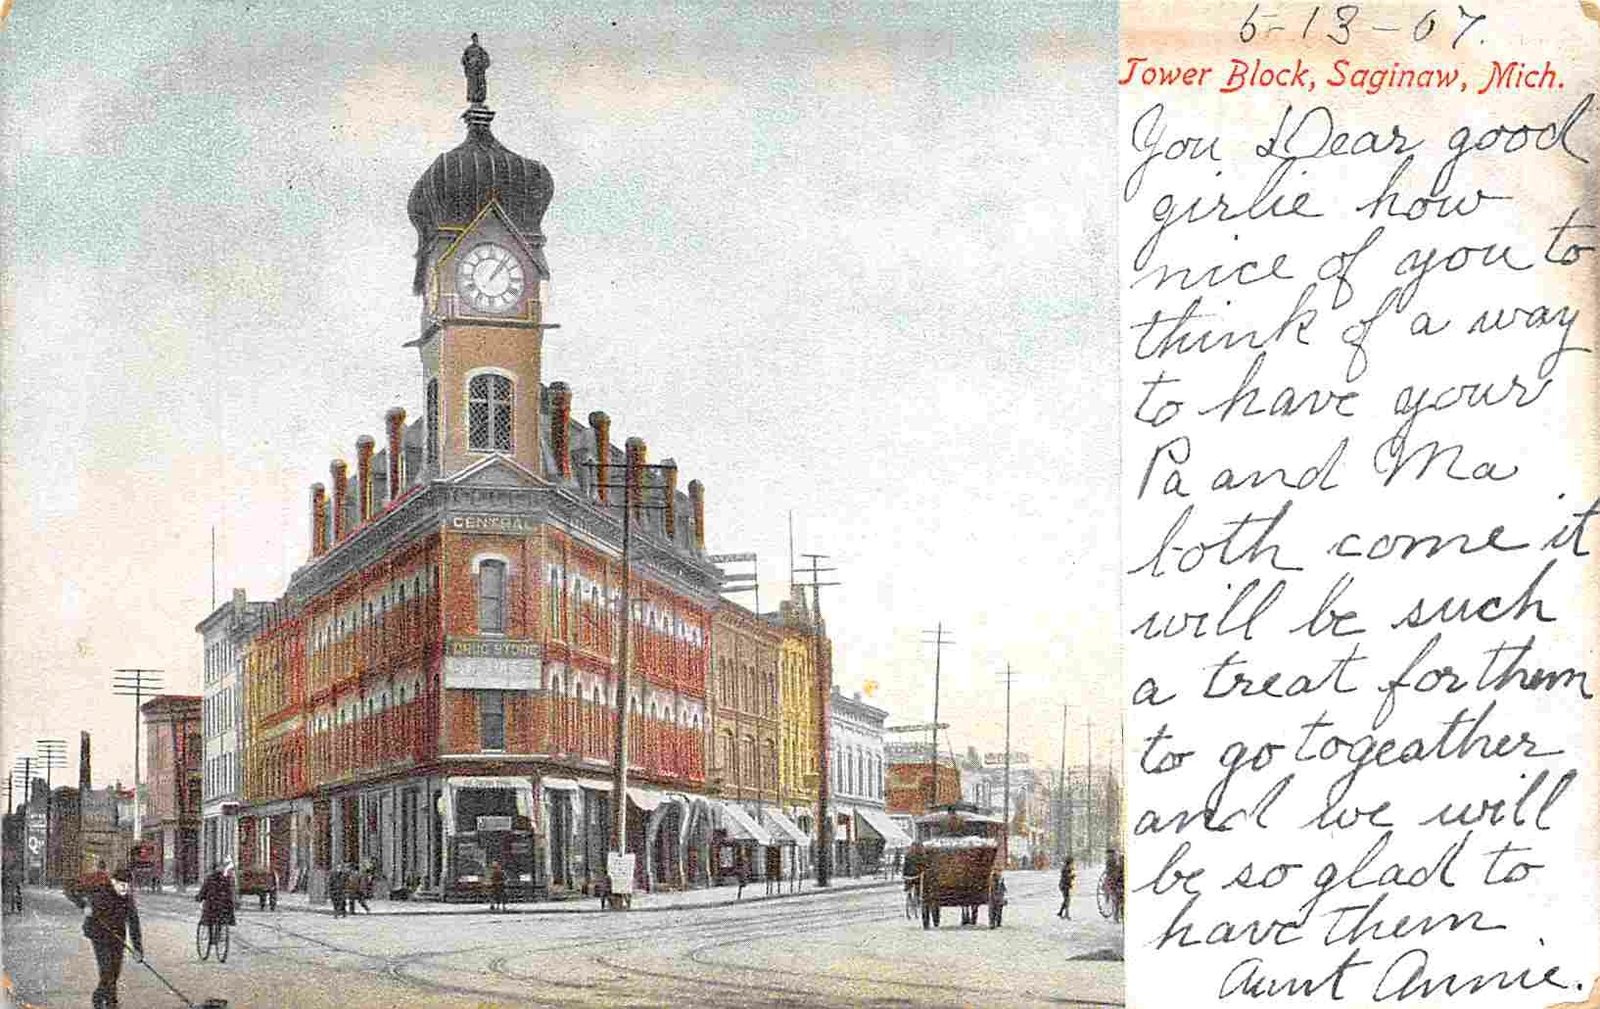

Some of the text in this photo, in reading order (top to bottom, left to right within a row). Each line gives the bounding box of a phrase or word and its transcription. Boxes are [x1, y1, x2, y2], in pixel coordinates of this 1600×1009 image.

[1124, 93, 1593, 200] You Dear good
[1134, 154, 1513, 271] girlie how
[1130, 207, 1596, 314] nice of you to
[1130, 283, 1592, 383] think of a way
[1134, 351, 1553, 453] to have your
[1137, 435, 1518, 500] Pa and Ma
[453, 516, 532, 530] CENTRAL
[1127, 492, 1598, 577] both come it
[1130, 559, 1557, 640] will be such
[1132, 633, 1594, 730] a treat for them
[1134, 769, 1578, 836] and we will
[1140, 700, 1565, 820] to go togeather
[1132, 830, 1546, 925] be so glad to
[1146, 892, 1507, 950] have them
[1218, 936, 1584, 1002] Aunt Annie.
